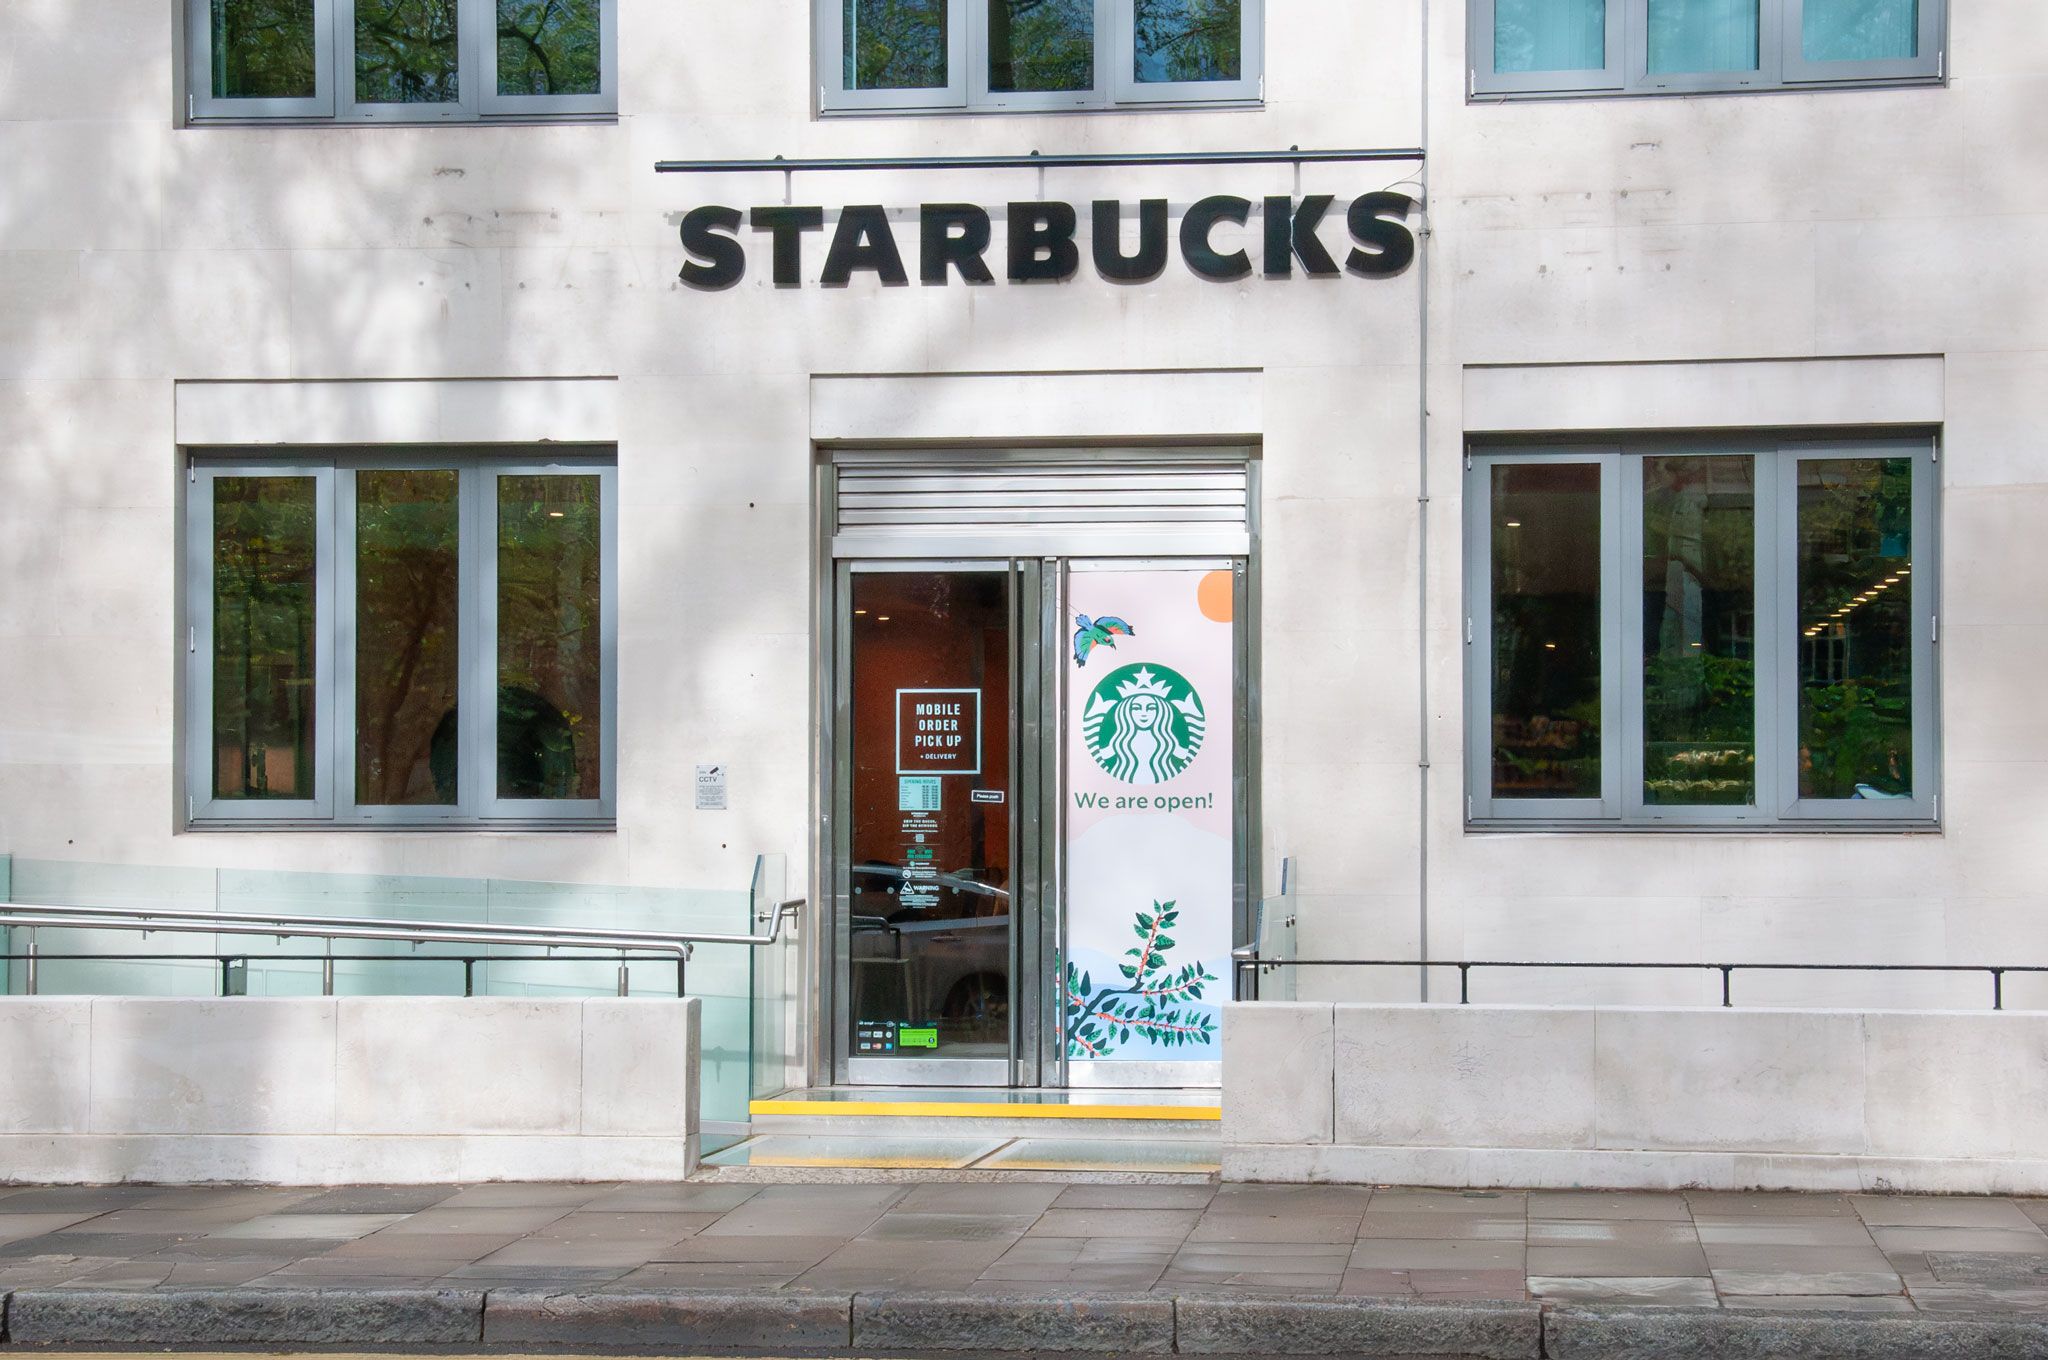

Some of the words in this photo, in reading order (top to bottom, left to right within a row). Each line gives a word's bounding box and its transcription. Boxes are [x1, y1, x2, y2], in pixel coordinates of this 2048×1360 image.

[678, 191, 1414, 289] STARBUCKS
[916, 704, 960, 715] MOBILE
[919, 720, 958, 731] ORDER
[915, 735, 942, 746] PICK
[946, 735, 961, 746] UP
[1074, 792, 1109, 809] We
[1115, 796, 1148, 809] are
[1154, 792, 1213, 813] open!
